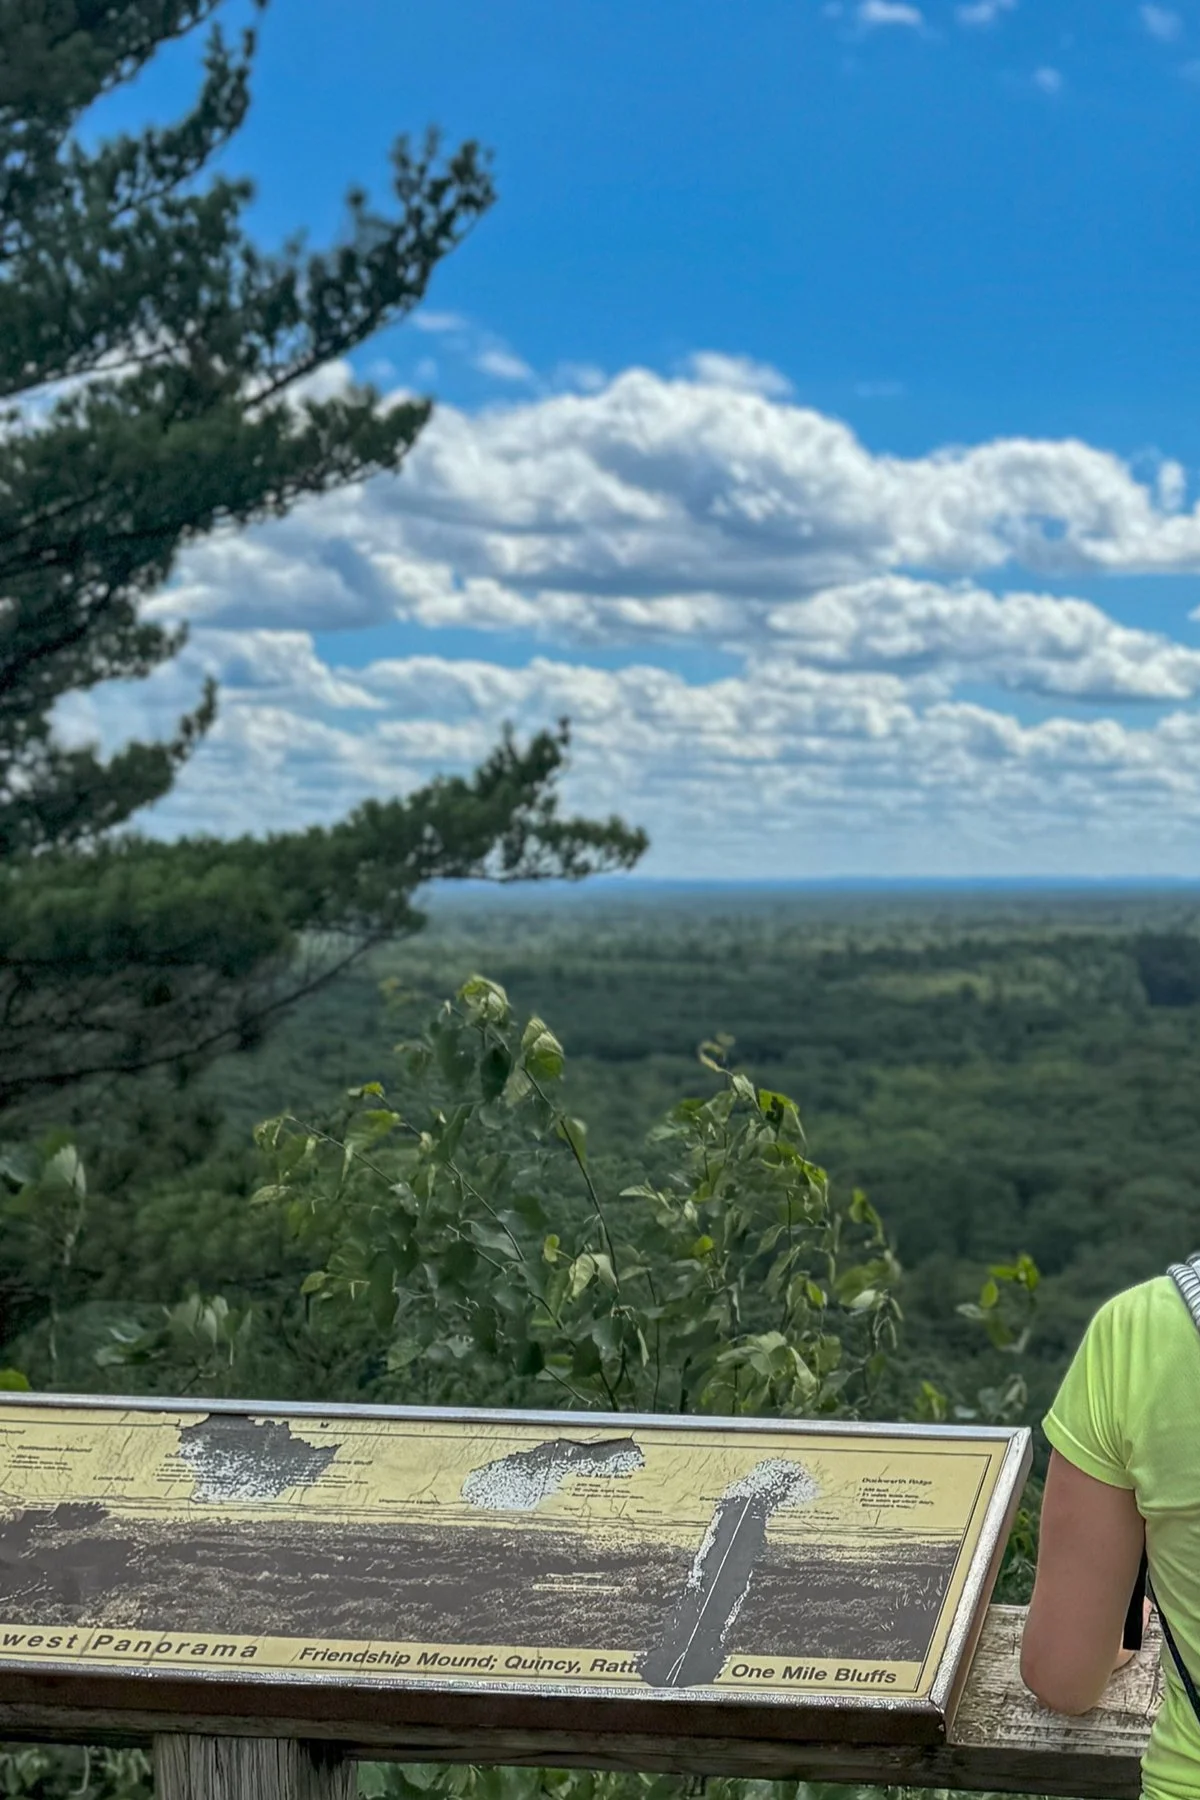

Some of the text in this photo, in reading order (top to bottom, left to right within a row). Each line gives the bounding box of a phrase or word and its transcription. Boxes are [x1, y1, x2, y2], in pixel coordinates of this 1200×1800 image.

[2, 1632, 897, 1684] west Panorama Friendship Mound; Quincy, Ratt One Mile Bluffs
